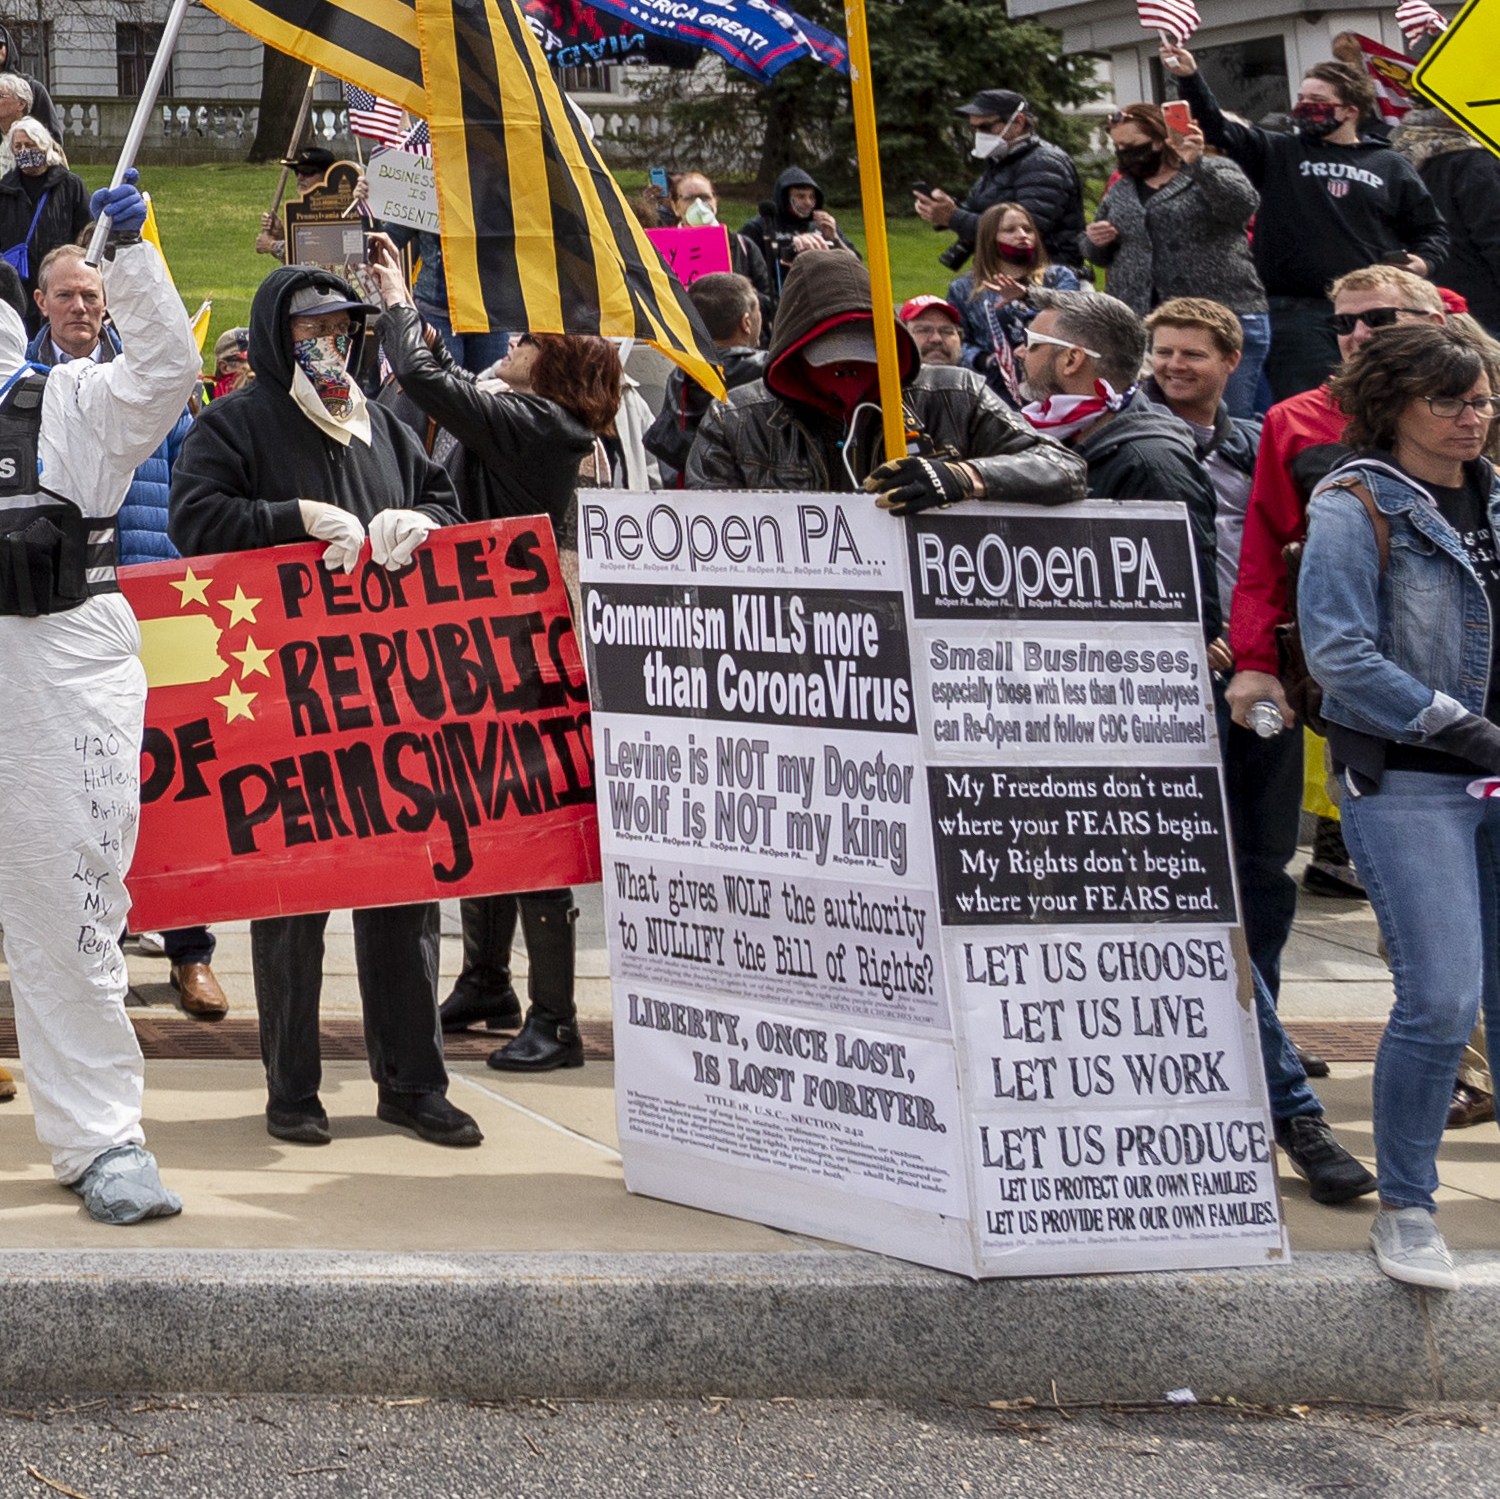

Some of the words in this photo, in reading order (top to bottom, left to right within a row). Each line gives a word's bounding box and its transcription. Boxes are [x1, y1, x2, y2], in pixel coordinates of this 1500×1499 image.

[698, 13, 769, 51] GREAT!
[407, 187, 427, 201] IS
[1299, 159, 1385, 190] TRUMP
[582, 503, 784, 573] ReOpen
[797, 504, 887, 566] PA...
[916, 531, 1101, 608] ReOpen
[1109, 536, 1187, 599] PA...
[276, 530, 552, 620] PEOPLE'S
[586, 589, 727, 650] Communism
[732, 593, 806, 655] KILLS
[813, 610, 879, 658] more
[279, 611, 590, 738] REPUBLIC
[642, 650, 708, 709] than
[716, 652, 911, 724] CoronaVirus
[930, 638, 1014, 672] Small
[1022, 641, 1200, 681] Businesses,
[74, 733, 120, 763] 420
[139, 716, 219, 806] OF
[603, 728, 682, 784] Levine
[689, 734, 709, 786] is
[716, 736, 770, 792] NOT
[777, 751, 815, 810] my
[823, 745, 914, 804] Doctor
[944, 771, 985, 806] My
[991, 771, 1098, 799] Freedoms
[1102, 771, 1156, 799] don't
[608, 780, 670, 835] Wolf
[682, 788, 706, 840] is
[714, 790, 778, 848] NOT
[786, 808, 832, 867] my
[841, 803, 908, 876] king
[84, 891, 112, 923] My
[963, 942, 1029, 987] LET
[1040, 941, 1087, 982] US
[1097, 937, 1229, 982] CHOOSE
[627, 993, 749, 1051] LIBERTY,
[755, 1020, 828, 1064] ONCE
[834, 1033, 916, 1084] LOST,
[693, 1051, 721, 1087] IS
[728, 1057, 796, 1104] LOST
[803, 1072, 948, 1135] FOREVER.
[979, 1124, 1046, 1171] LET
[1057, 1124, 1106, 1168] US
[1115, 1120, 1271, 1167] PRODUCE
